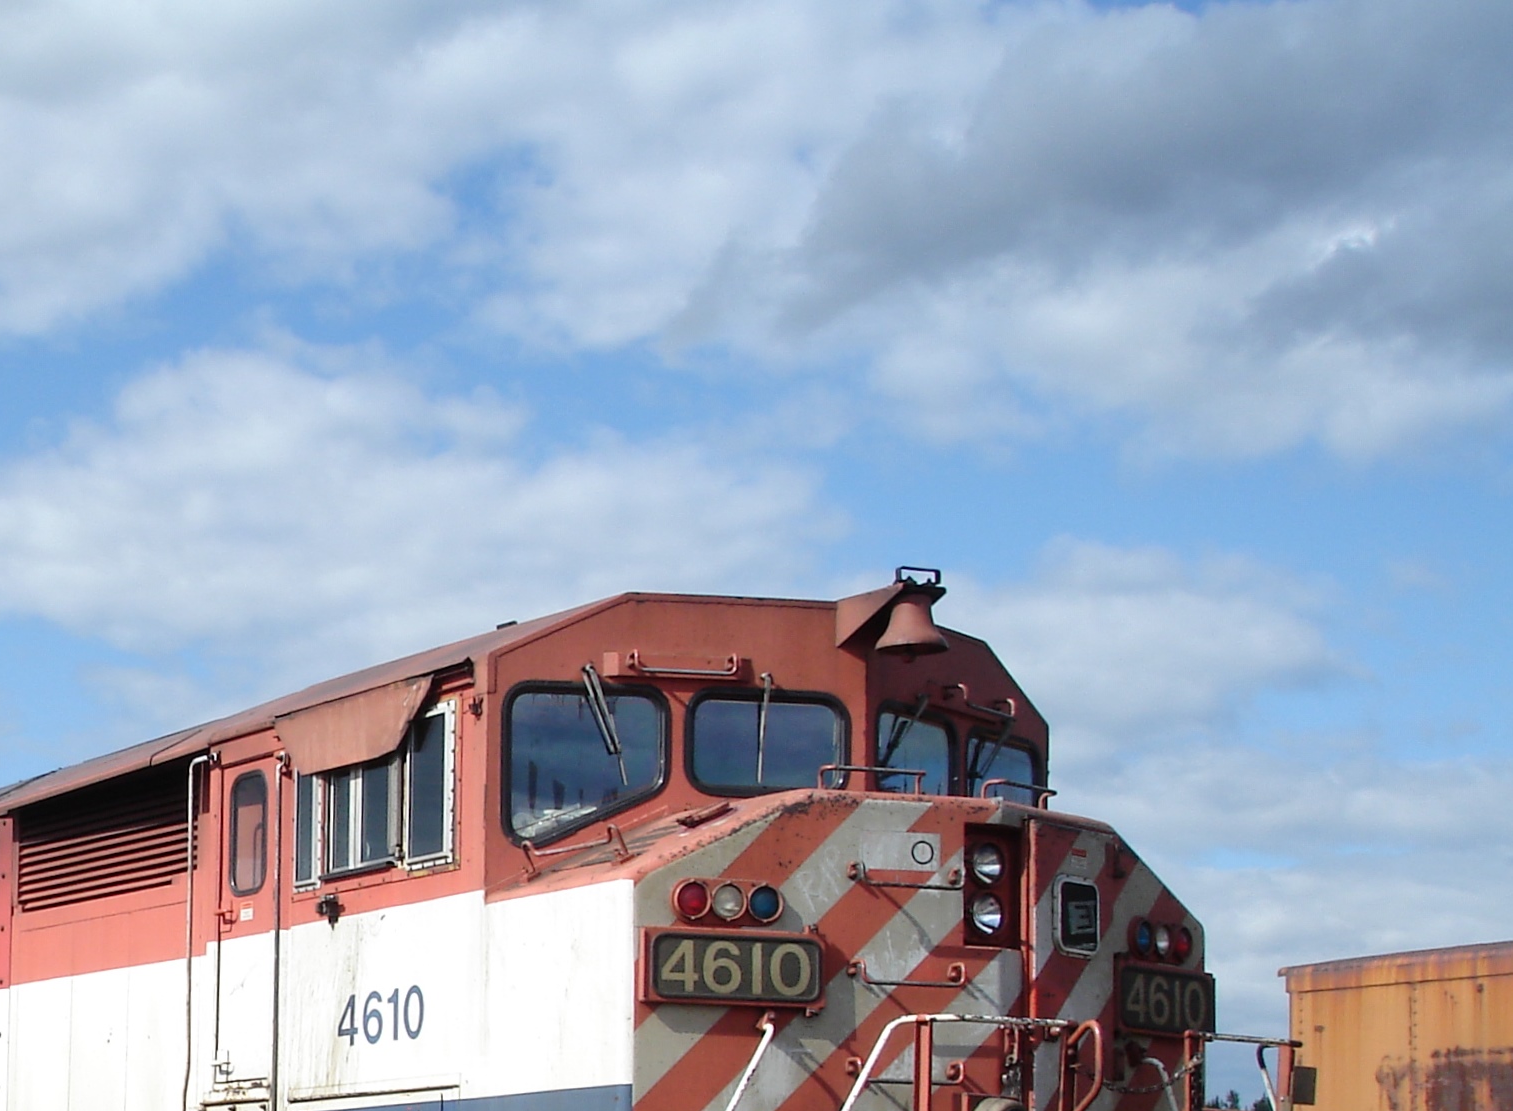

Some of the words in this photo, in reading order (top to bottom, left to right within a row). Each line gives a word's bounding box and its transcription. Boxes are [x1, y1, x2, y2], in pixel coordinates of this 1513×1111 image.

[660, 939, 812, 997] 4610
[337, 984, 425, 1047] 4610
[1126, 973, 1206, 1031] 4610
